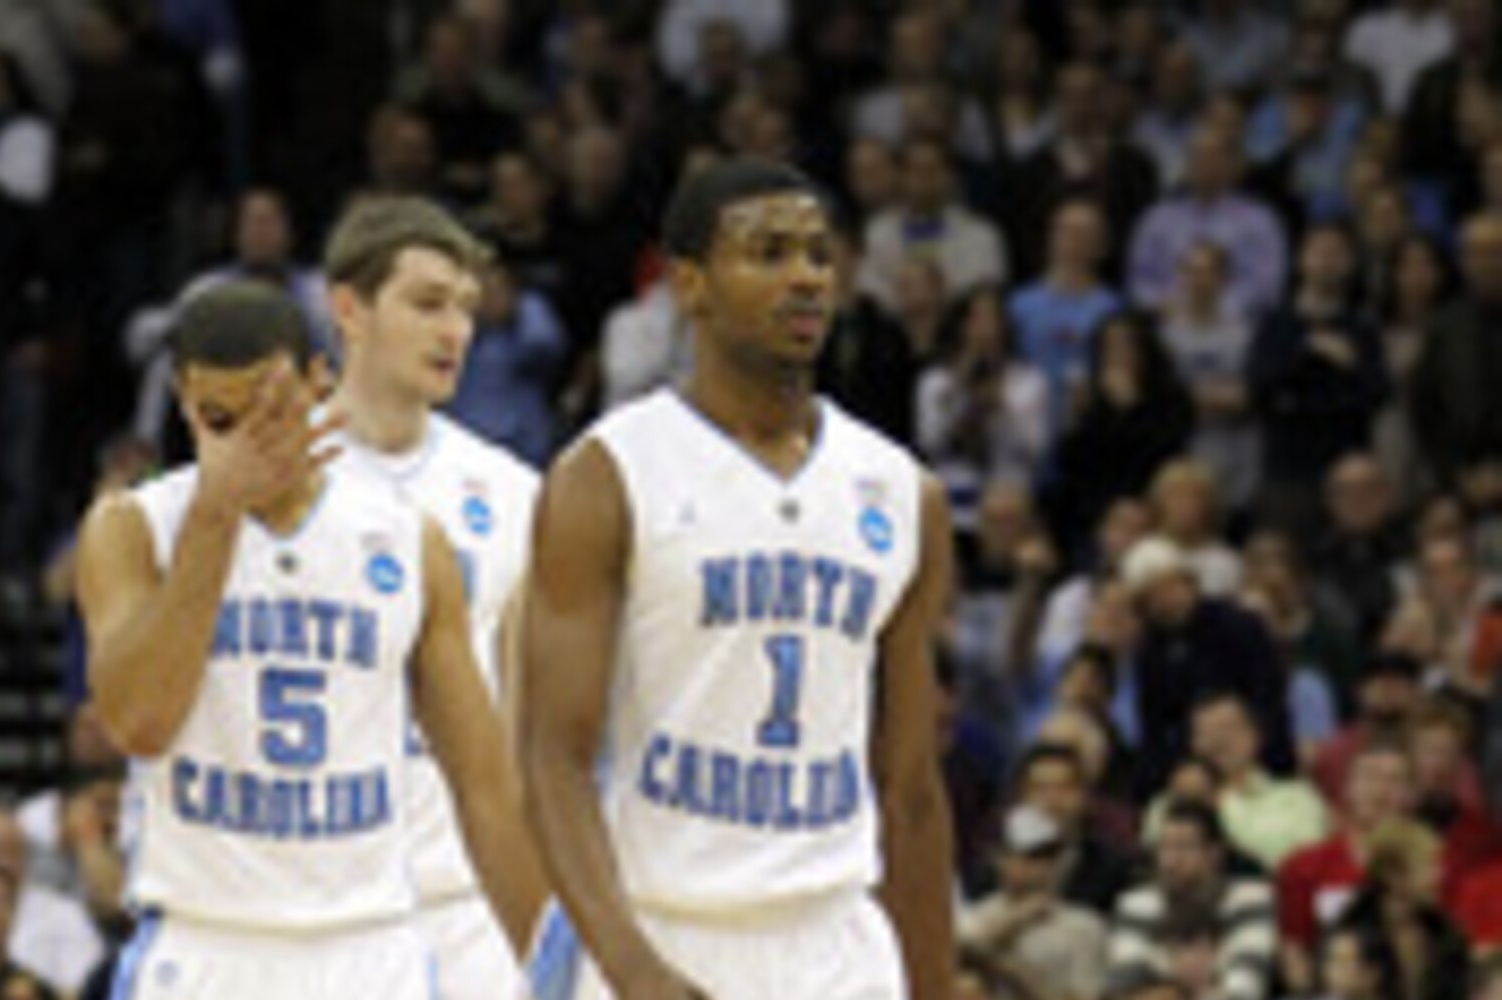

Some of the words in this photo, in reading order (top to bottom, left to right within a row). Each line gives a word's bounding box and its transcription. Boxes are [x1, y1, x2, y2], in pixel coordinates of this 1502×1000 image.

[210, 597, 378, 670] NORTH
[697, 549, 878, 642] NORTH
[259, 665, 327, 768] 5
[756, 633, 804, 748] 1
[171, 755, 392, 840] CAROLINA
